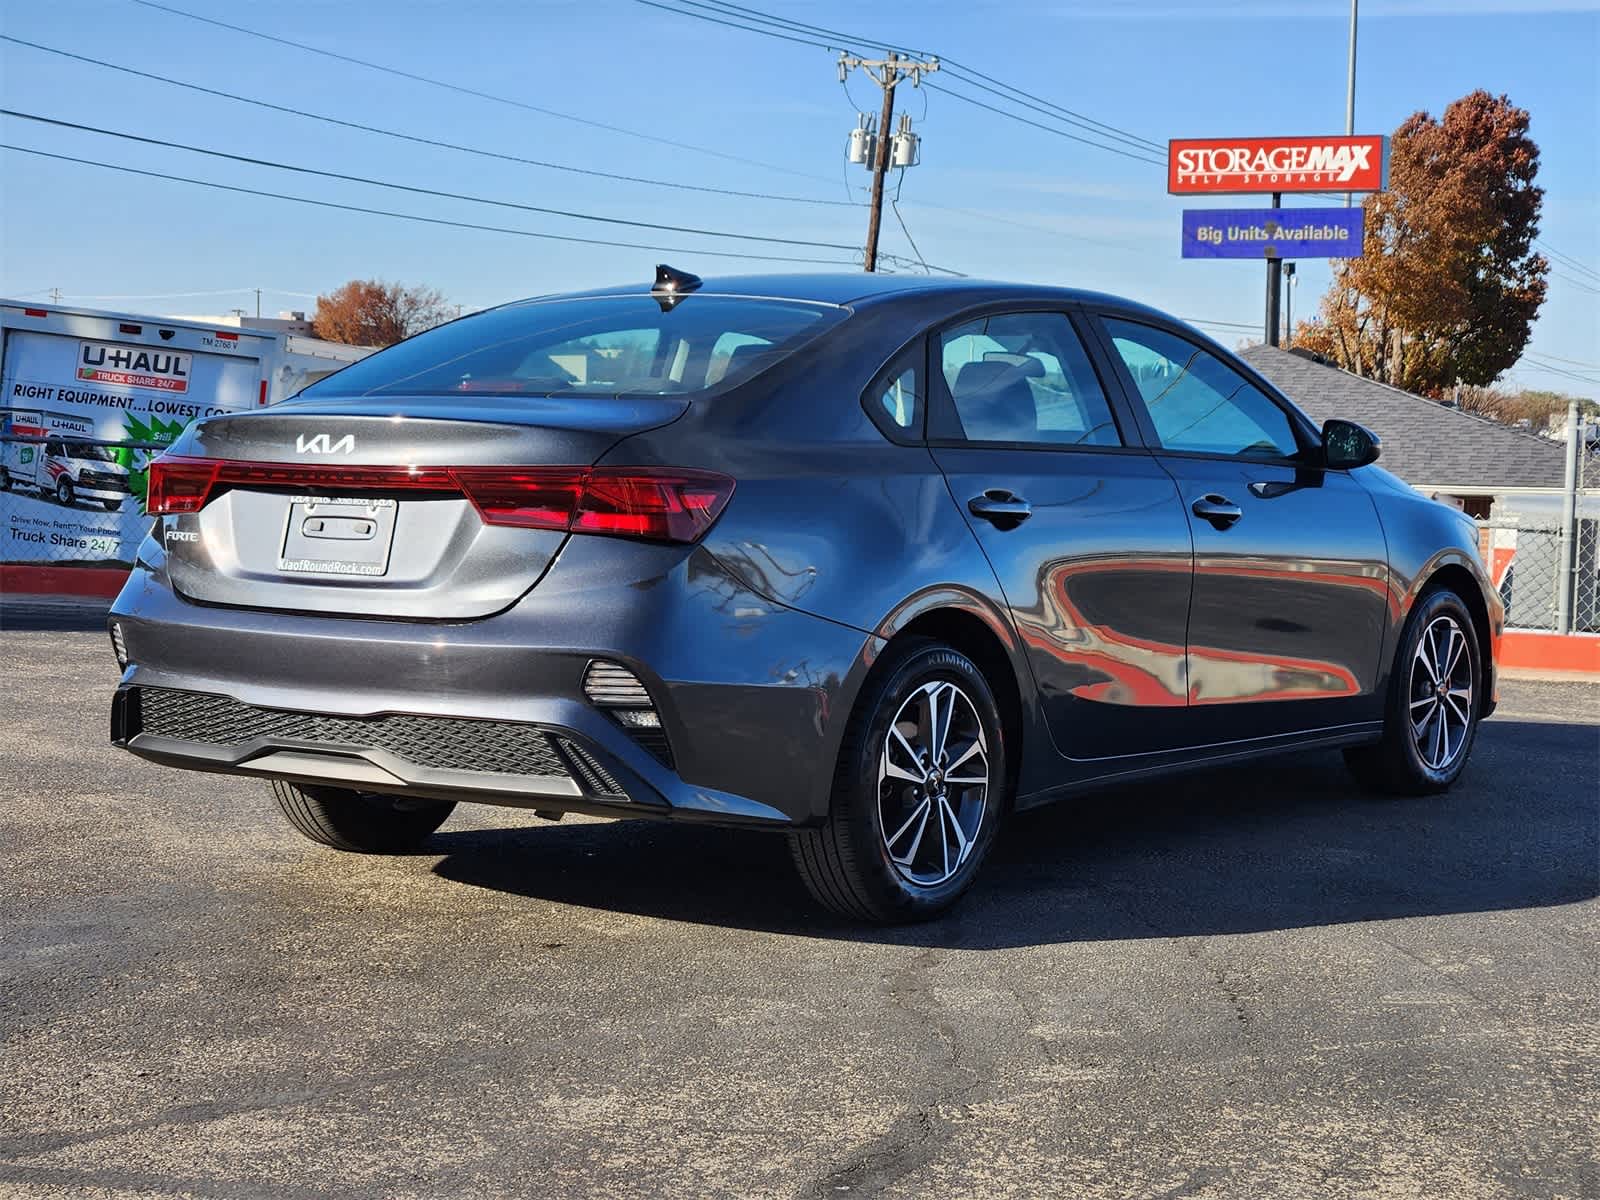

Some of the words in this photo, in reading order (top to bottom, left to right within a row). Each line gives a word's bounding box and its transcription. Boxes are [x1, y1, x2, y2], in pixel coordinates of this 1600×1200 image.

[1178, 174, 1223, 184] SELF
[1244, 173, 1334, 184] STORAGE
[1197, 227, 1223, 244] Big
[1228, 227, 1269, 241] Units
[1273, 225, 1349, 241] Available
[83, 346, 186, 376] U-HAUL
[97, 372, 125, 383] TRUCK
[127, 375, 156, 386] SHARE
[157, 379, 176, 388] 24/7
[13, 384, 54, 400] RIGHT
[52, 420, 86, 432] U-HAUL
[296, 433, 355, 455] KIA
[79, 524, 96, 534] Your
[166, 531, 199, 542] FORTE
[10, 527, 46, 544] Truck
[50, 533, 87, 549] Share
[90, 538, 120, 553] 24/7
[928, 653, 973, 673] KUMHO
